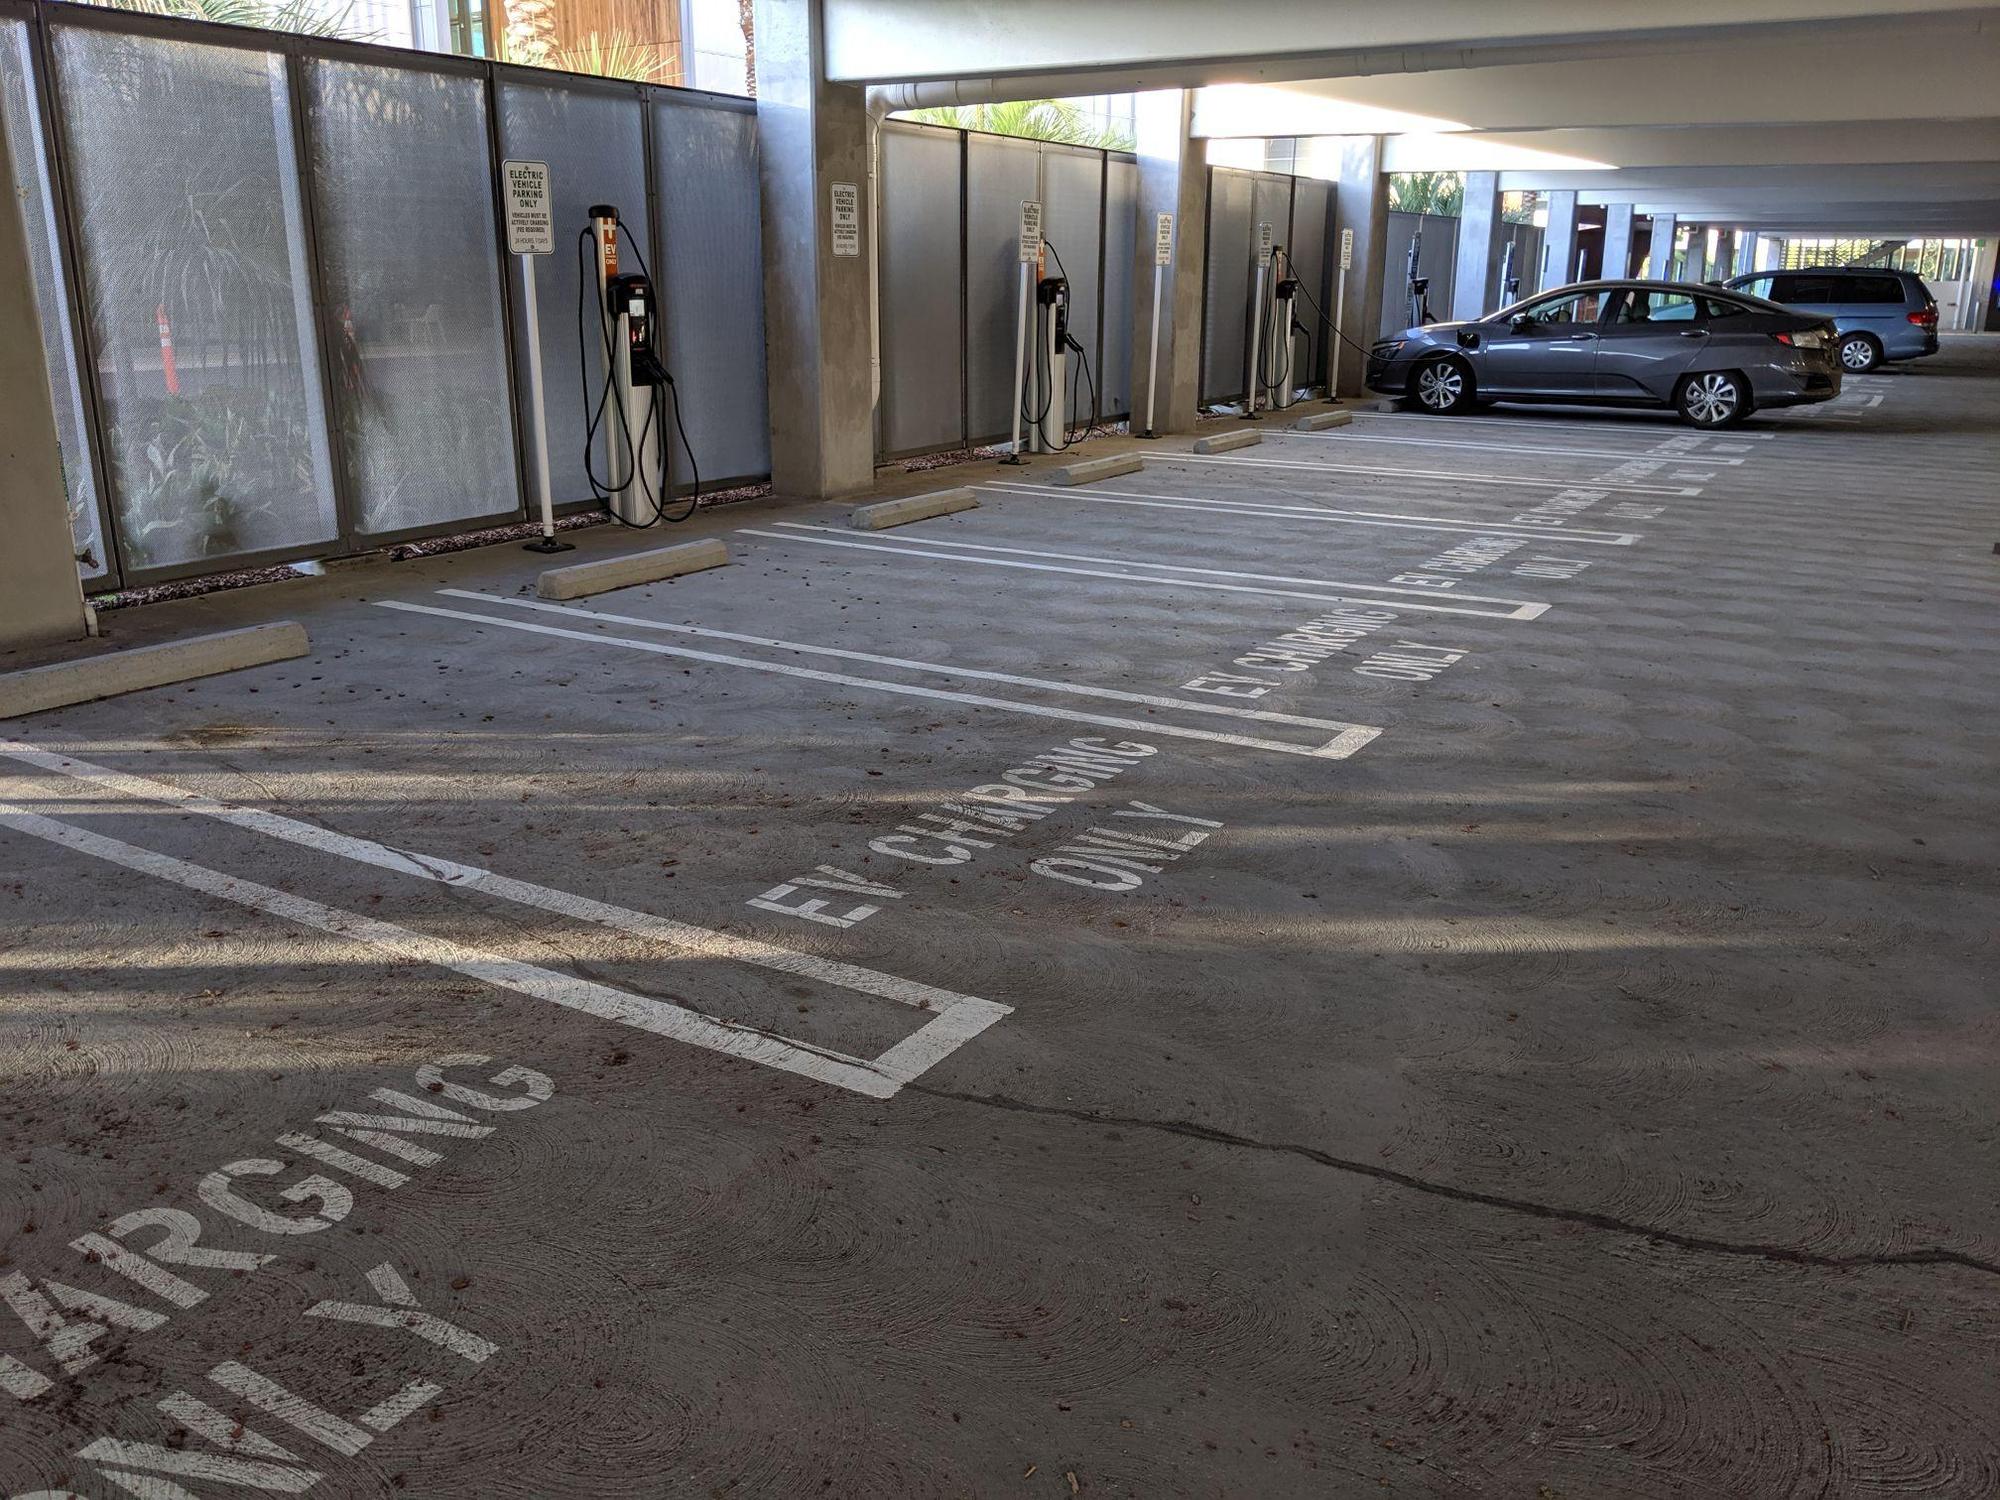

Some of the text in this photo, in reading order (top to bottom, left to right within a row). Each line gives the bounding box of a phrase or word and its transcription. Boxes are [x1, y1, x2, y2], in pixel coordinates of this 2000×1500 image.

[510, 170, 543, 179] ELECTRIC
[512, 180, 542, 189] VEHICLE
[513, 189, 543, 198] PARKING
[519, 199, 537, 208] ONLY
[834, 190, 855, 198] ELECTRIC
[605, 243, 616, 255] EV
[1180, 608, 1399, 699] EV CHARGING
[1352, 640, 1470, 681] ONLY
[745, 736, 1158, 929] EV CHARGING
[1029, 800, 1224, 892] ONLY
[0, 1053, 556, 1399] ARGING
[10, 1262, 500, 1500] NLY
